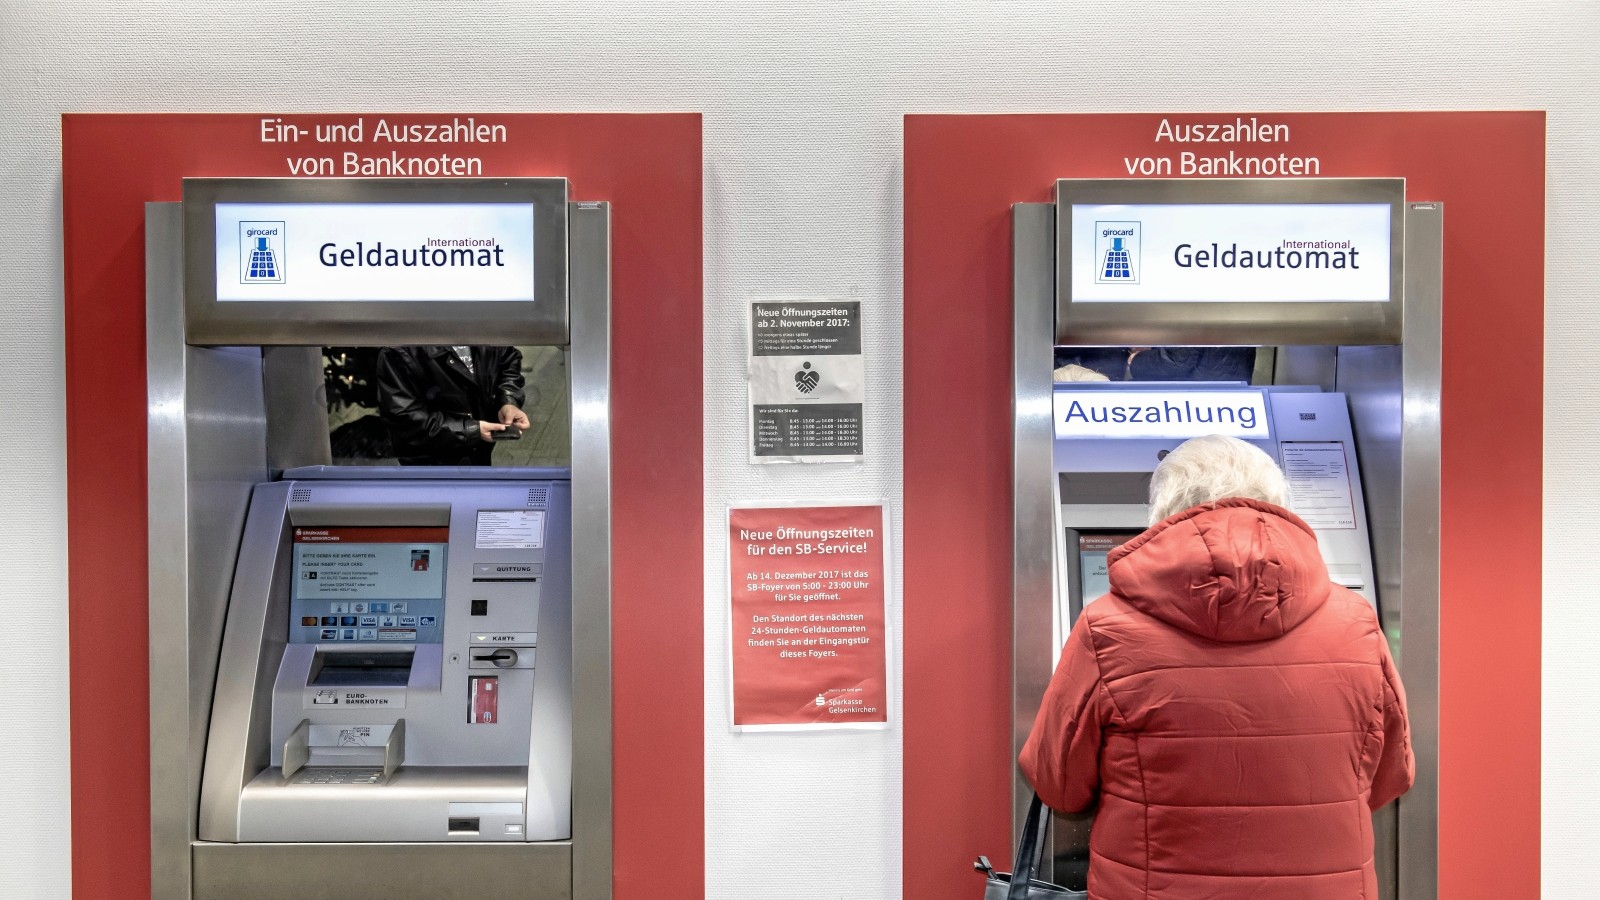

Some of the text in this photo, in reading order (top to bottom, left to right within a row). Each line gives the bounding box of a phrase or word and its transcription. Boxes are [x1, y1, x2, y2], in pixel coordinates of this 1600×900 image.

[261, 118, 507, 143] Ein- und Auszahlen
[1155, 118, 1289, 143] Auszahlen
[287, 152, 482, 175] von Banknoten
[1124, 152, 1320, 175] von Banknoten
[247, 228, 278, 238] girocard
[1102, 228, 1134, 238] girocard
[427, 237, 495, 247] International
[1283, 239, 1350, 249] International
[319, 242, 504, 268] Geldautomat
[1174, 243, 1360, 269] Geldautomat
[758, 307, 848, 318] Neue Öffnungszeiten
[1064, 400, 1256, 428] Auszahlung
[740, 526, 873, 541] Neue Öffnungszeiten
[747, 542, 867, 555] für den SB-Service!
[854, 570, 868, 578] das
[747, 583, 783, 592] SB-Foyer
[804, 592, 840, 602] geöffnet.
[771, 614, 807, 622] Standort
[751, 625, 866, 635] 24-Stunden-Geldautomaten
[748, 638, 774, 647] finden
[819, 637, 869, 646] Eingangstür
[780, 650, 838, 659] dieses Foyers.
